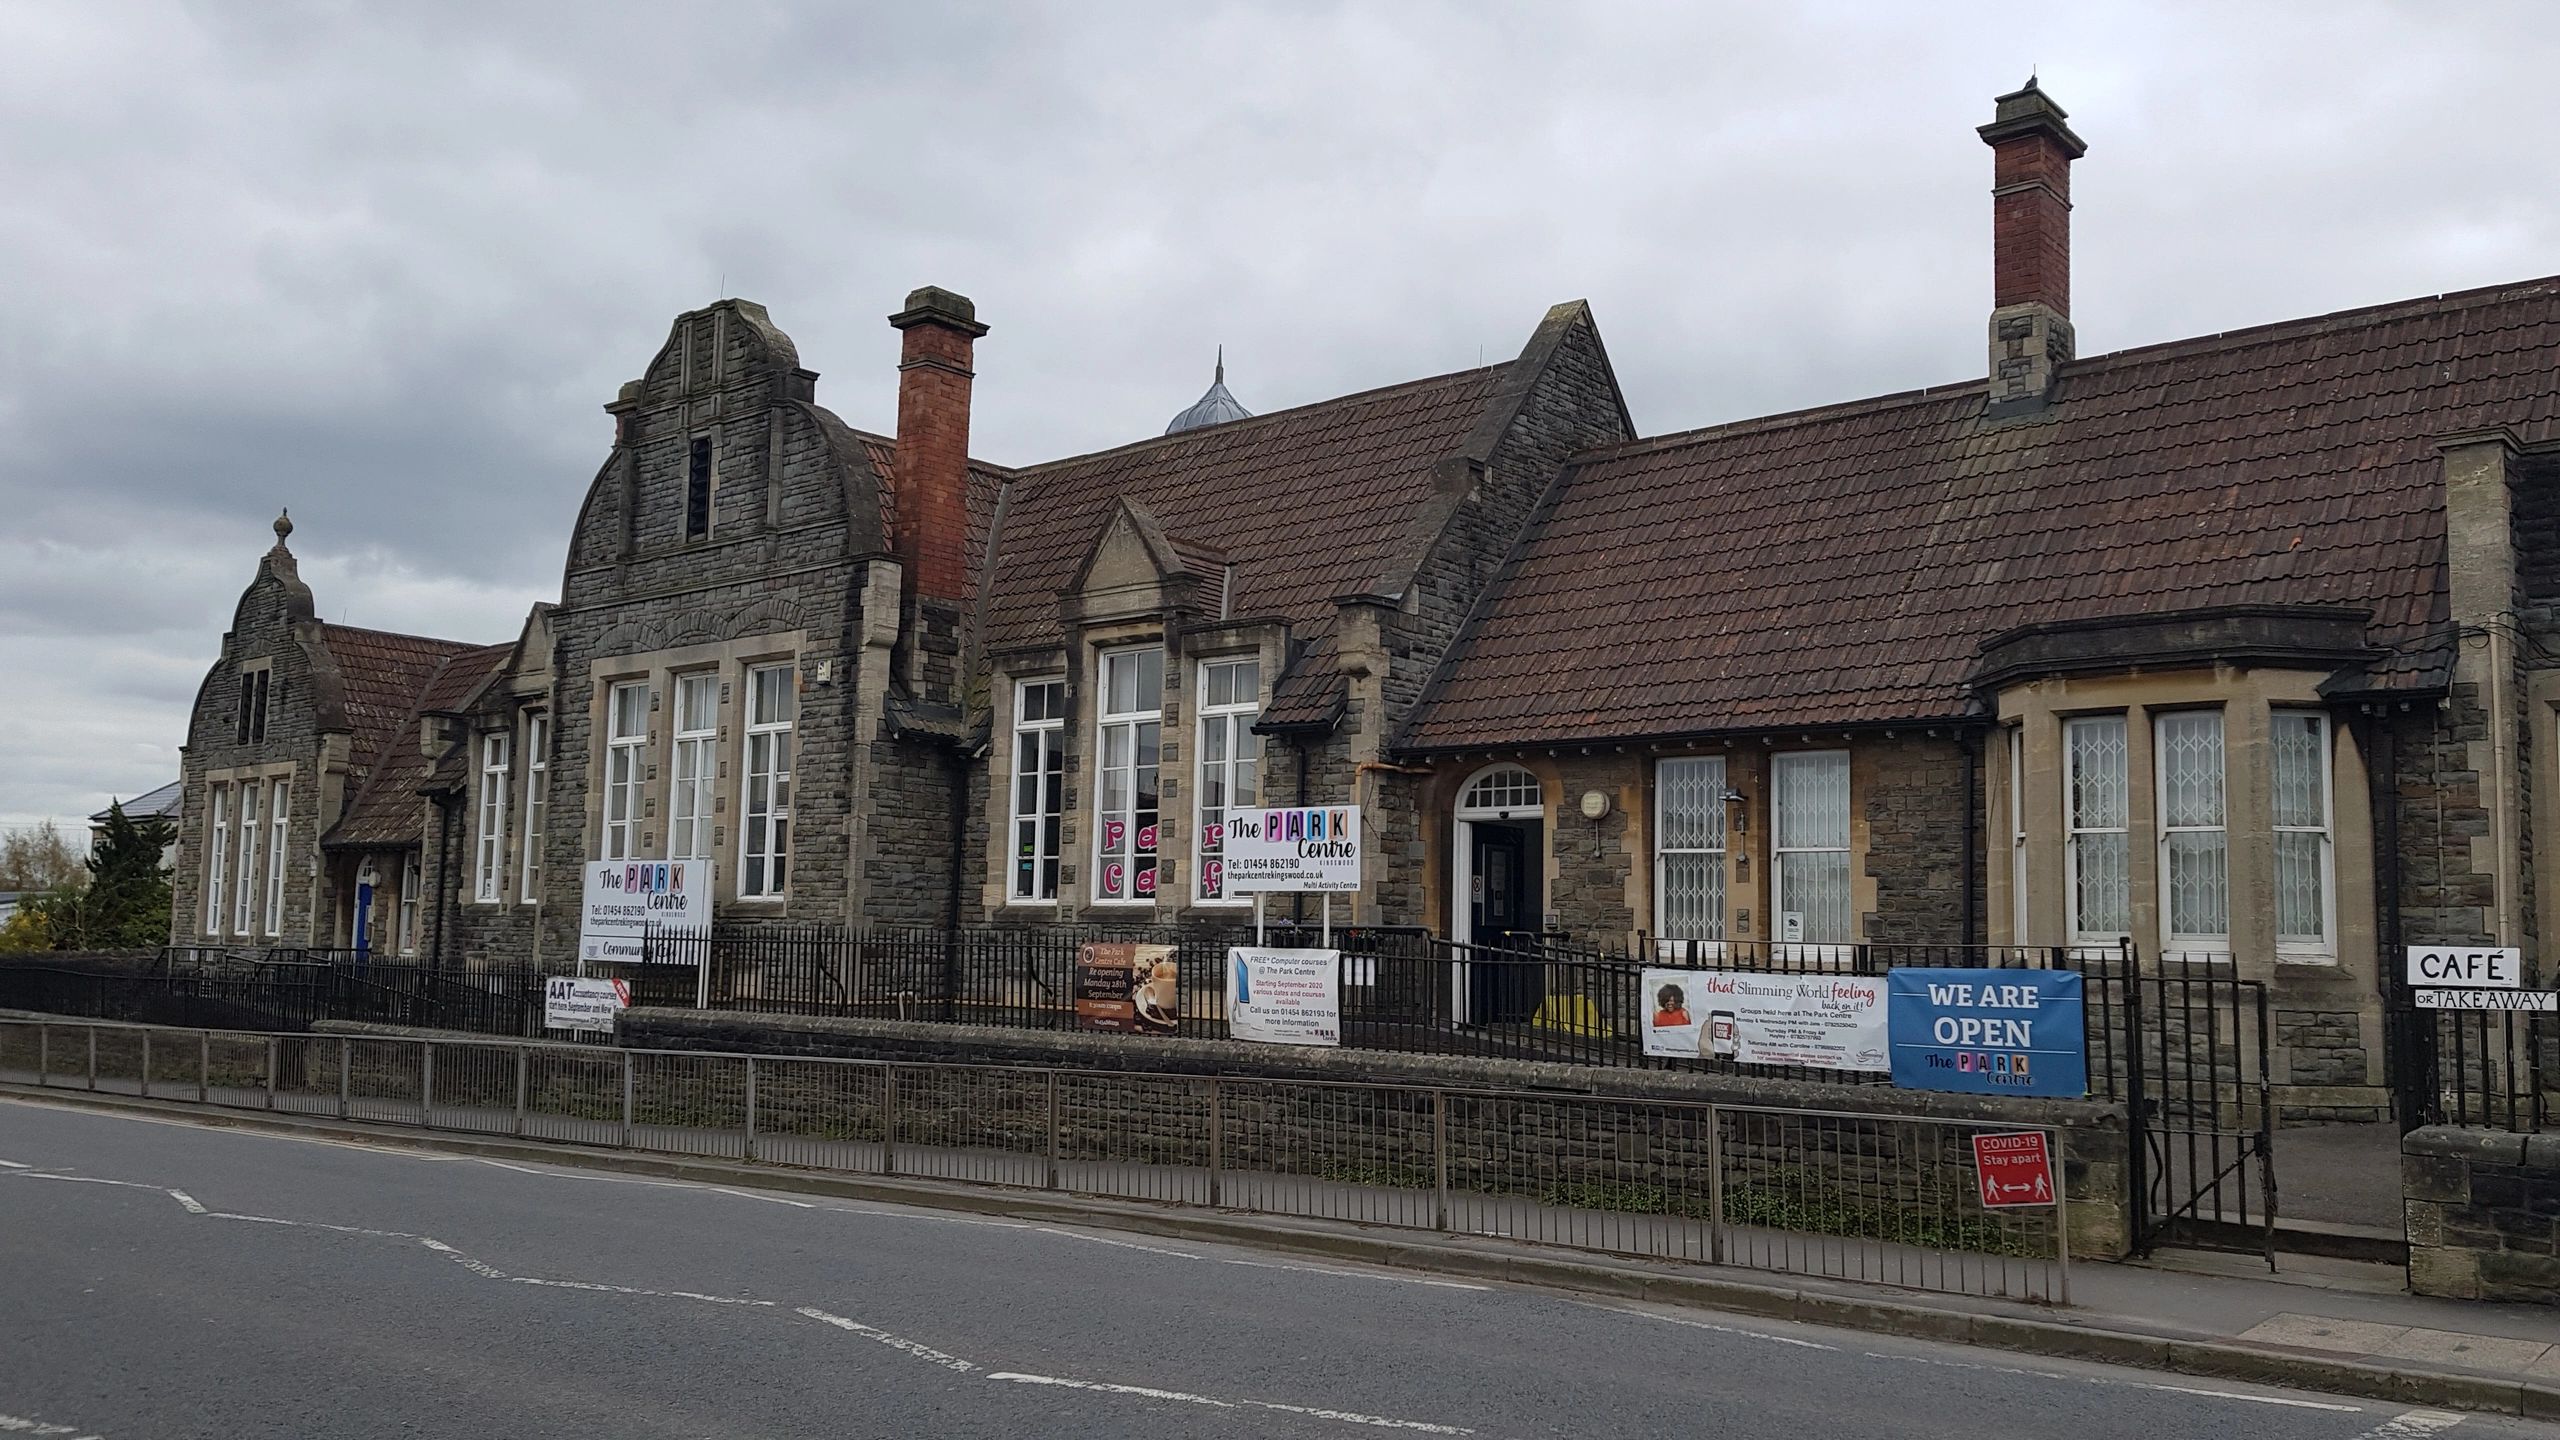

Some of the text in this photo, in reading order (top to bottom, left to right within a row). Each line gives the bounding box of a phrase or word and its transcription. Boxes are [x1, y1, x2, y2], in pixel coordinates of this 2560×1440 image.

[1228, 812, 1345, 839] The PARK
[1104, 818, 1223, 851] Par
[1298, 838, 1356, 858] Centre
[1228, 858, 1300, 869] Tel: 01454 862190
[600, 866, 682, 890] The PARK
[1104, 860, 1222, 897] Caf
[1228, 870, 1324, 882] theparkcentrekingswood.co.uk
[1318, 880, 1339, 890] Activity
[647, 890, 688, 910] Centre
[592, 905, 645, 916] Tel: 01454 862190
[590, 917, 662, 928] theparkcentrekingswoo.co.uk
[603, 942, 654, 964] Communy
[1271, 957, 1300, 966] Computer
[1294, 968, 1316, 976] Centre
[549, 981, 574, 1000] AAT
[1084, 979, 1126, 989] Monday 28th
[1256, 980, 1276, 988] Starting
[1278, 980, 1308, 989] September
[1088, 990, 1124, 1000] September
[1706, 977, 1875, 1008] that Slimming World feeling
[1928, 984, 2040, 1009] WE ARE
[2417, 995, 2434, 1004] OR
[1250, 1006, 1261, 1014] Call
[1280, 1008, 1300, 1016] 01454
[1301, 1009, 1325, 1017] 862193
[1822, 1001, 1840, 1011] back
[1282, 1019, 1319, 1027] information
[1934, 1016, 2033, 1048] OPEN
[1925, 1053, 2027, 1073] The PARK
[1986, 1072, 2034, 1086] Centre
[1981, 1136, 2038, 1150] COVID-19
[1983, 1152, 2042, 1166] Stay apart
